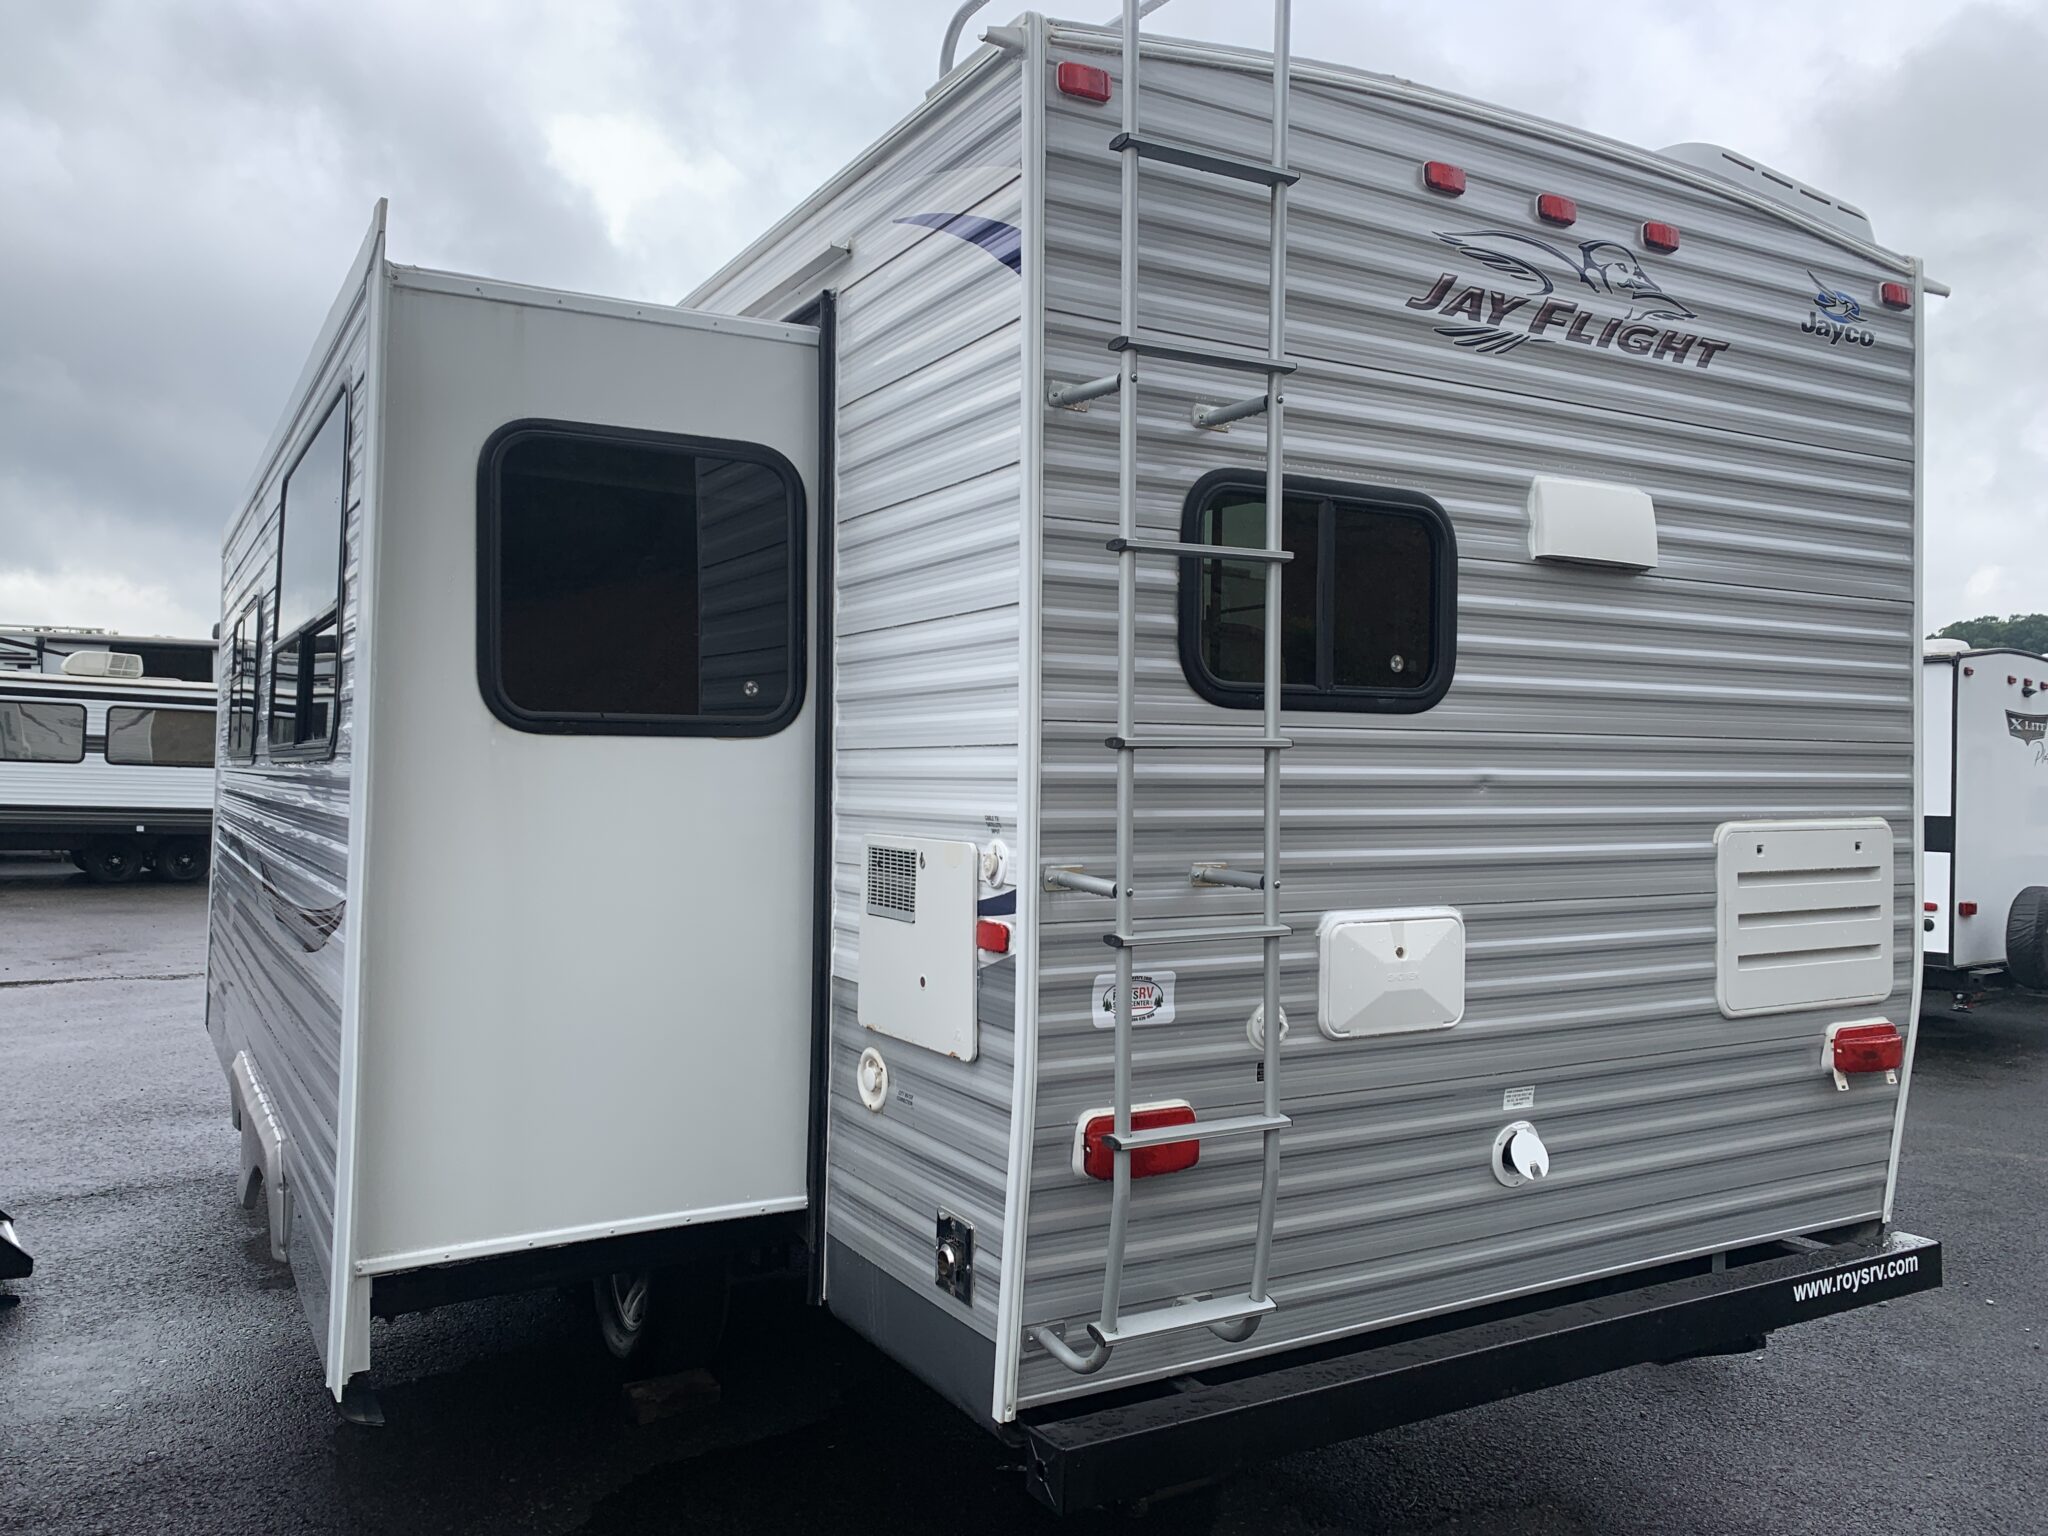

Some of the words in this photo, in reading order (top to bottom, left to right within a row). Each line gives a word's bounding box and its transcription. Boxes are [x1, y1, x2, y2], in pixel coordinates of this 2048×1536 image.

[1405, 272, 1531, 326] JAY
[1528, 296, 1730, 368] FLIGHT
[1801, 311, 1875, 347] Jayco
[1793, 1255, 1918, 1302] www.roysrv.com
